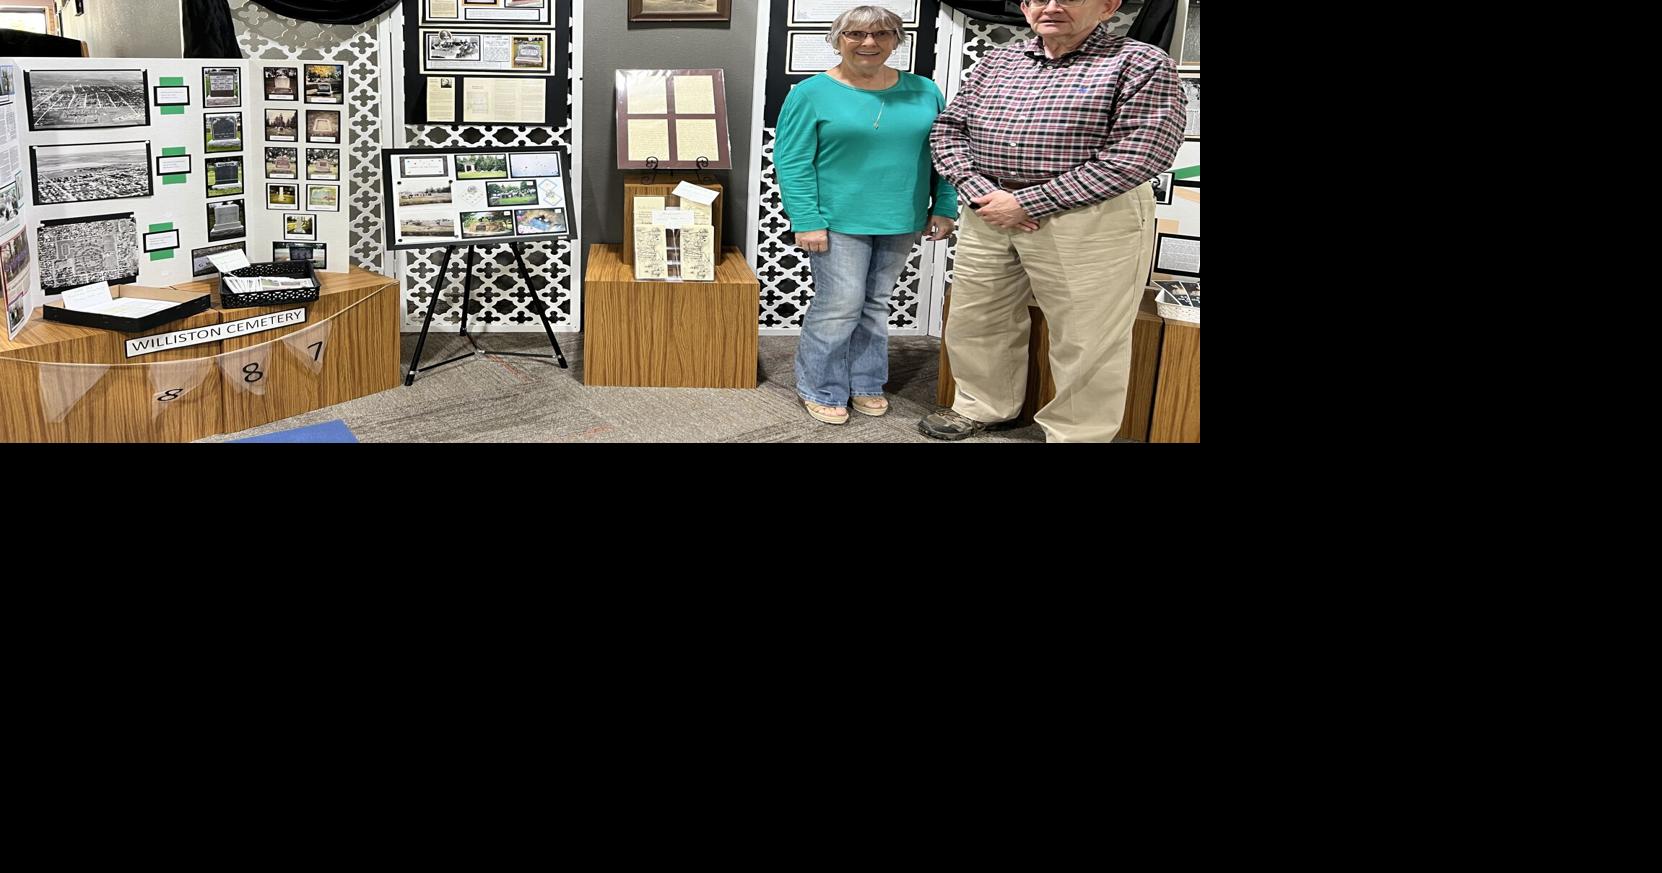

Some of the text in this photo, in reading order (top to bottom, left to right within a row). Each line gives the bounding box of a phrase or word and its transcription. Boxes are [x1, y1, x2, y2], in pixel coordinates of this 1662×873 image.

[132, 310, 302, 351] WILLISTON CEMETERY
[157, 341, 323, 401] 8 8 7
